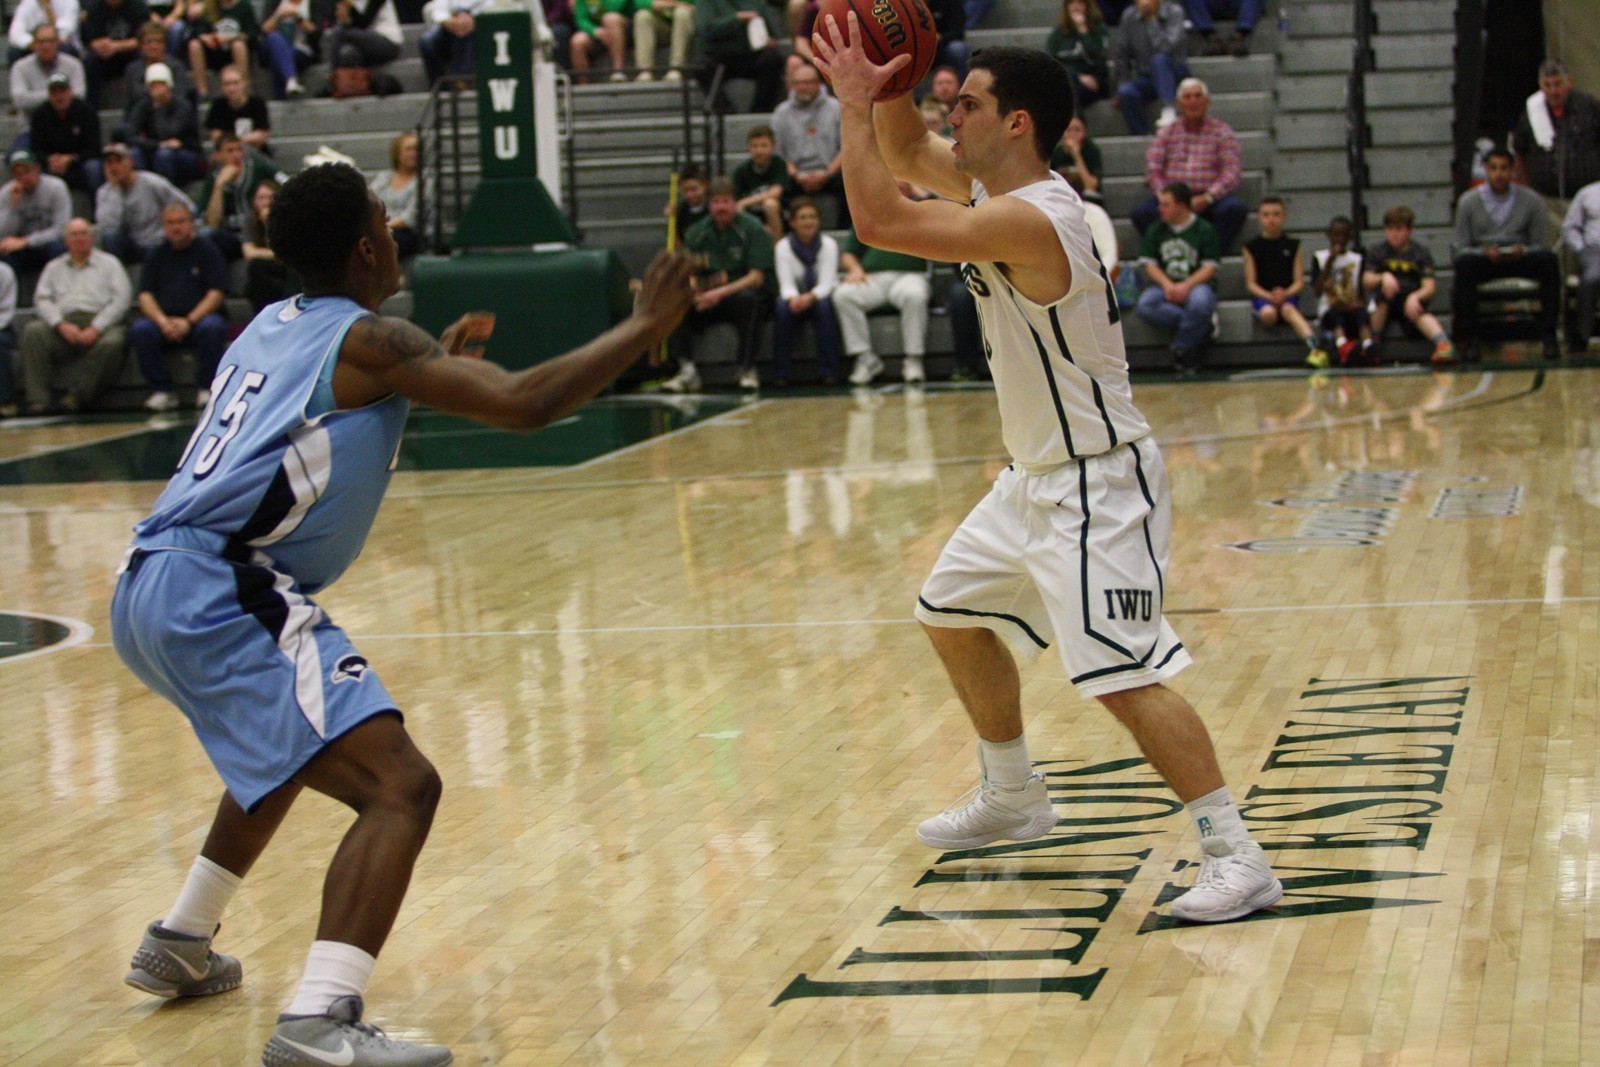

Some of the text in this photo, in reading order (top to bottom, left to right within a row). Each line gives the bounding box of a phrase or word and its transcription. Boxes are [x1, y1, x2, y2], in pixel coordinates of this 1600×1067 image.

[488, 31, 518, 160] IWU
[176, 363, 268, 481] 15
[1103, 588, 1152, 622] IWU
[1136, 675, 1477, 935] WESLEYAN
